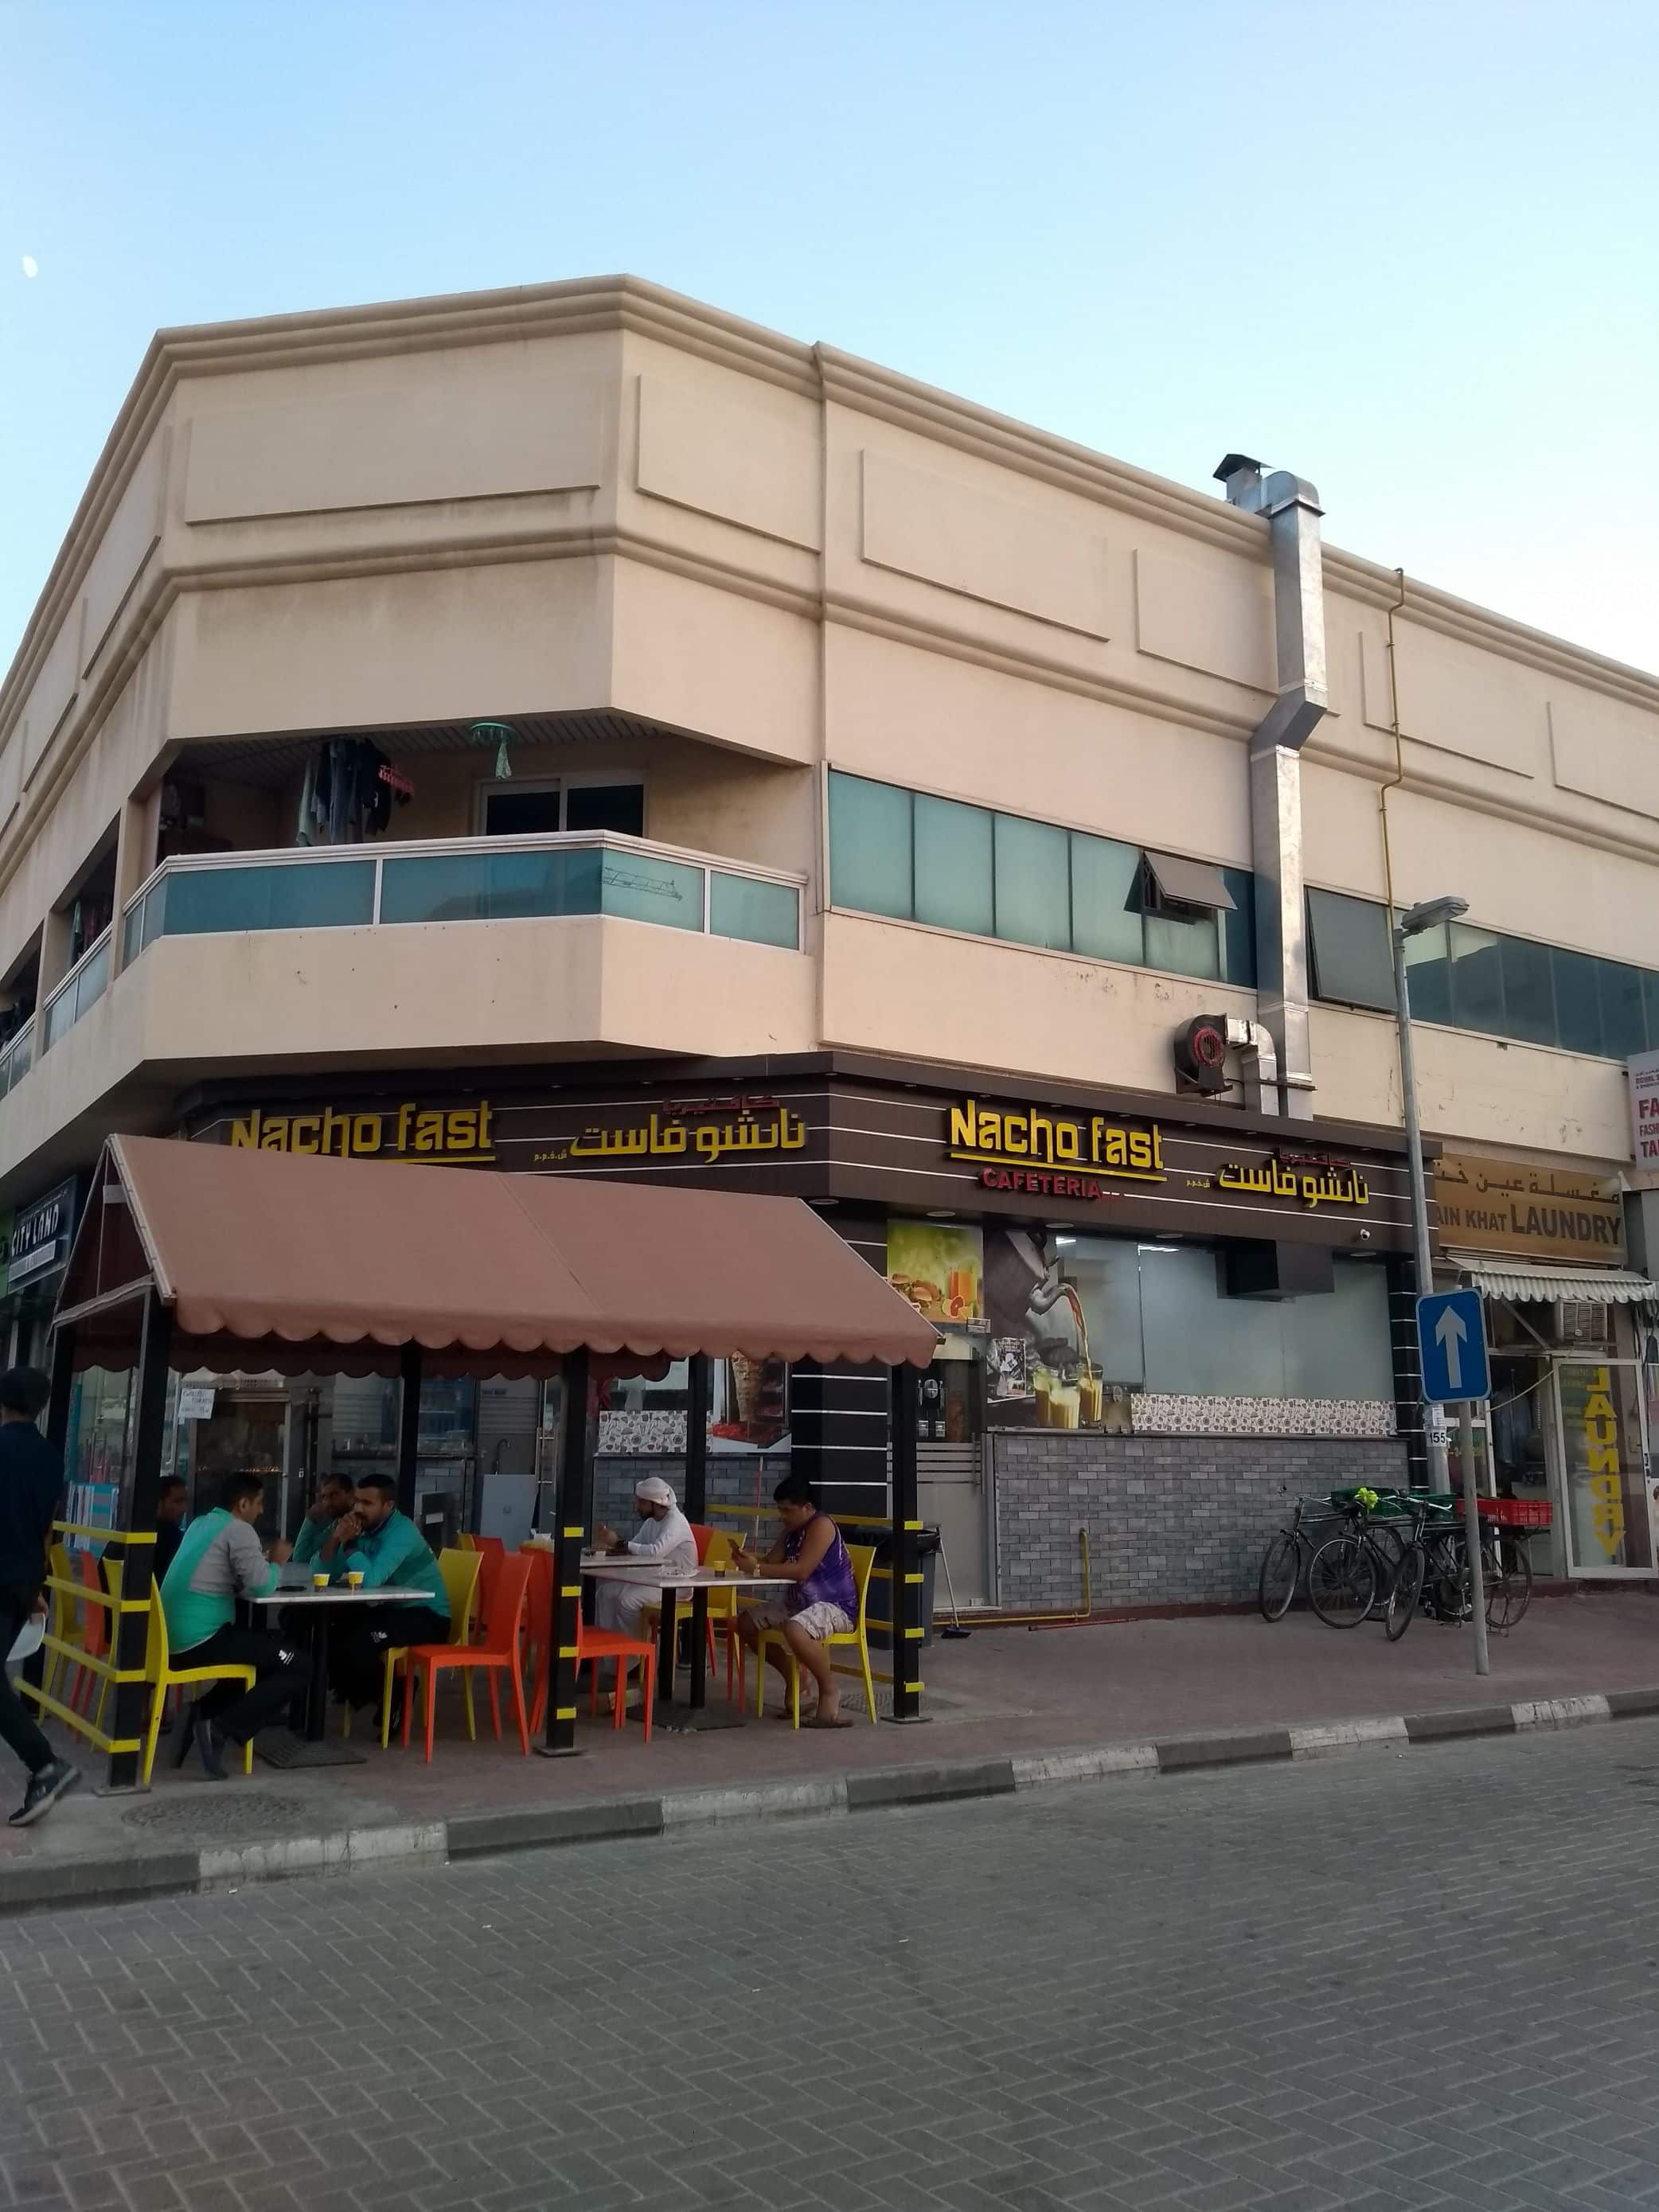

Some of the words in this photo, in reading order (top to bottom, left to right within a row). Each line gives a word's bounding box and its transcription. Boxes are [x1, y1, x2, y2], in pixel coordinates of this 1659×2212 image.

[232, 1106, 382, 1159] Nacho
[398, 1100, 493, 1152] fast
[569, 1114, 686, 1156] فاست
[951, 1099, 1079, 1163] Nacho
[1092, 1116, 1164, 1169] fast
[982, 1168, 1103, 1199] CAFETERIA
[1220, 1159, 1297, 1196] فاست
[1476, 1172, 1524, 1197] عين
[1529, 1172, 1620, 1204] مغسلة
[12, 1223, 31, 1257] CITY
[33, 1203, 59, 1245] LAND
[1466, 1210, 1507, 1231] KHAT
[1510, 1204, 1622, 1245] LAUNDRY
